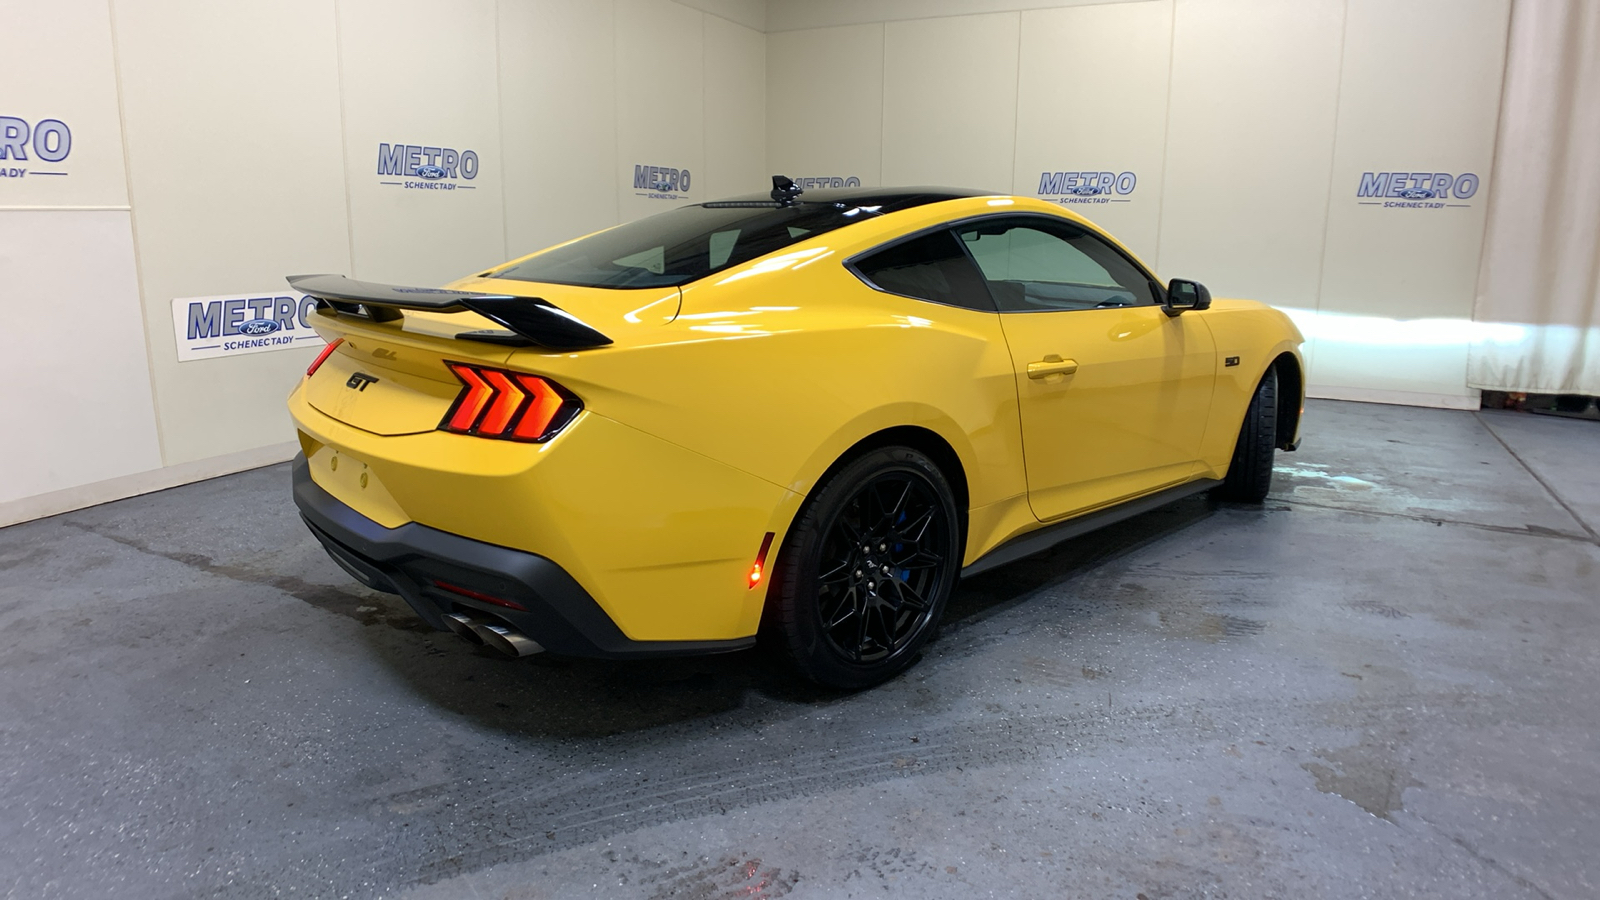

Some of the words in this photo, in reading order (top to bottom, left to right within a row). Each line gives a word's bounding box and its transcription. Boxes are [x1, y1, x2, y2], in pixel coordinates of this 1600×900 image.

[377, 143, 479, 180] METRO
[404, 181, 457, 190] SCHENECTADY
[633, 164, 691, 192] METRO
[1038, 171, 1137, 195] METRO
[1357, 172, 1480, 200] METRO
[1383, 201, 1446, 209] SCHENECTADY
[246, 322, 272, 334] Ford
[223, 336, 294, 351] SCHENECTADY
[346, 371, 380, 392] GT
